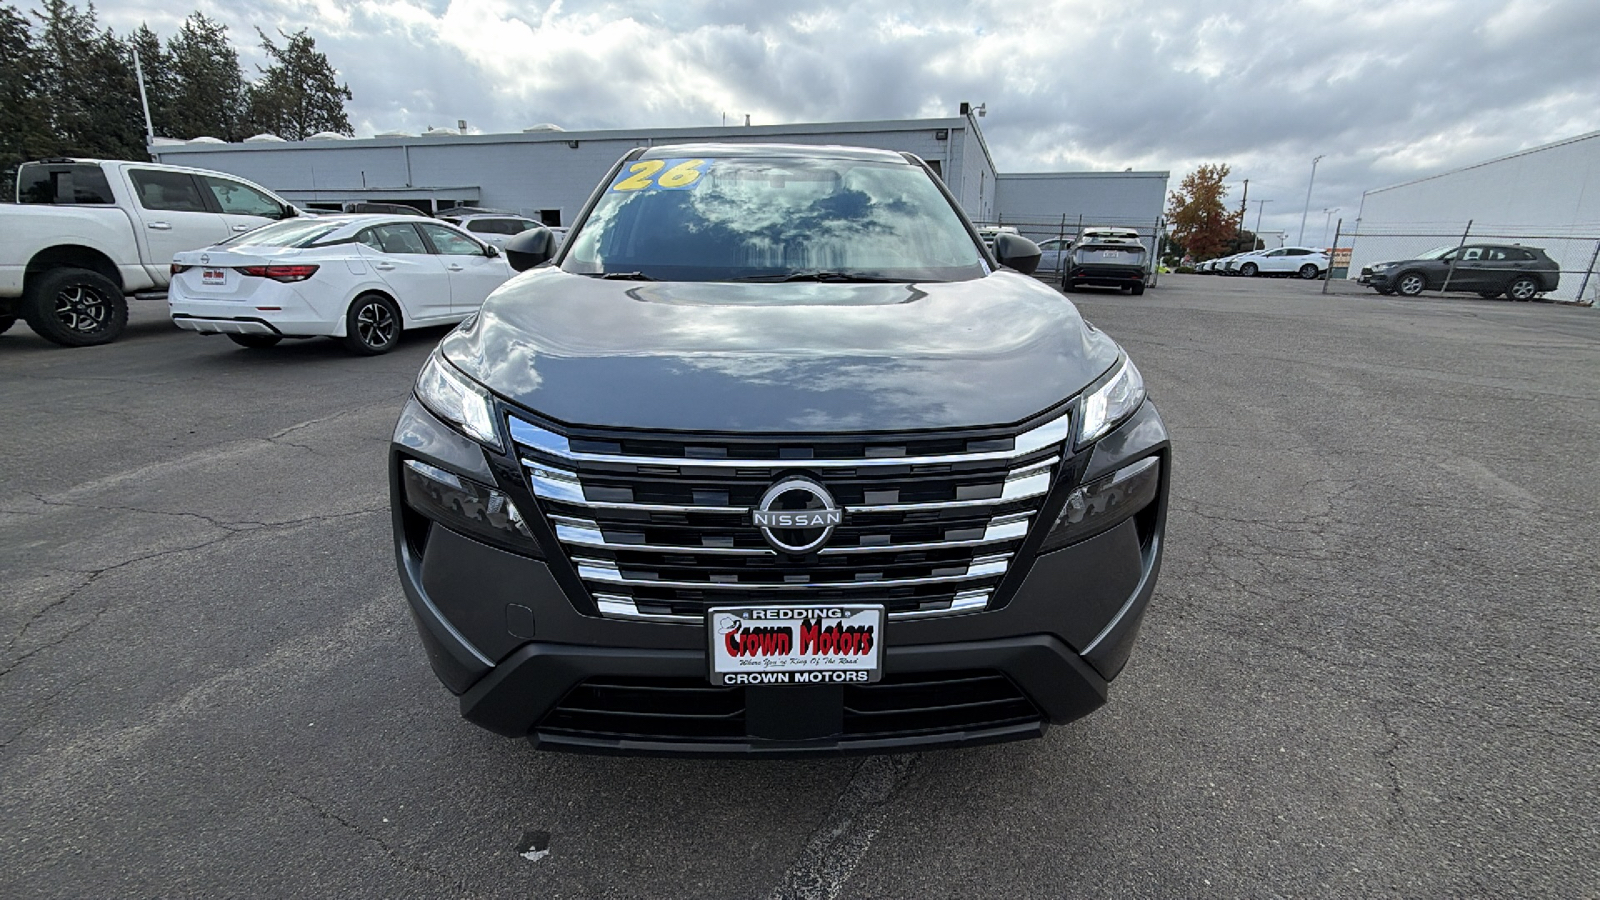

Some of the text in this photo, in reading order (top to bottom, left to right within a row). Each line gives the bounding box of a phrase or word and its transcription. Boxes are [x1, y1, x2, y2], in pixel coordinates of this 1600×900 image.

[614, 160, 704, 190] 26
[755, 513, 839, 526] NISSAN
[753, 608, 842, 619] REDDING
[725, 619, 874, 657] Crown Motors
[790, 657, 807, 666] King
[809, 657, 820, 666] Of
[838, 657, 859, 665] Road
[724, 672, 868, 684] CROWN MOTORS
